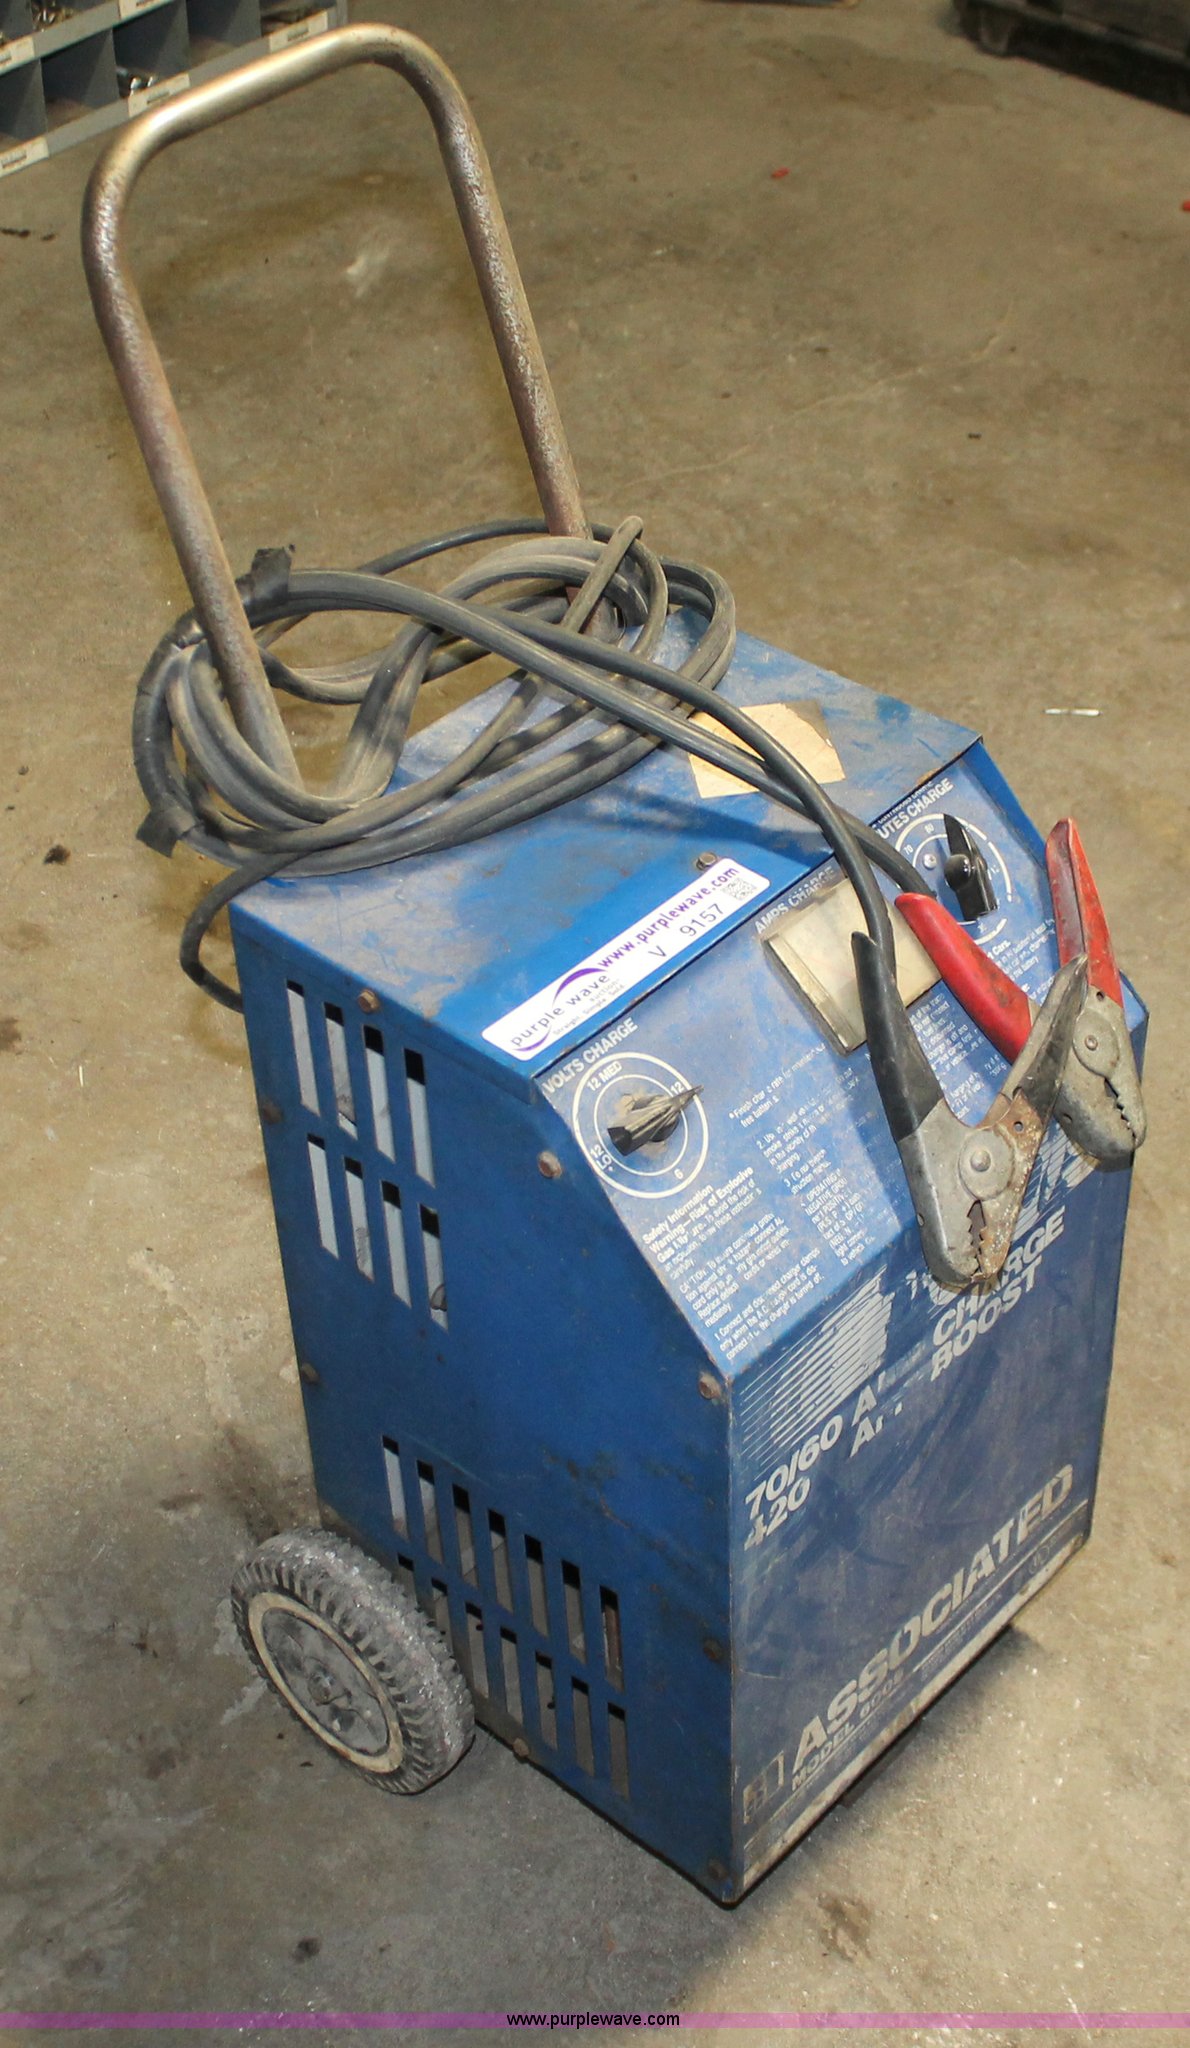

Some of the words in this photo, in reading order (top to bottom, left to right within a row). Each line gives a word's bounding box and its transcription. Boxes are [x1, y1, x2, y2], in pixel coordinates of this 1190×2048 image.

[875, 810, 910, 840] UTES
[905, 777, 953, 817] CHARGE
[903, 844, 914, 854] 70
[753, 901, 789, 933] AMPS
[786, 865, 837, 907] CHARGE
[599, 866, 739, 970] www.purplewave.com
[649, 945, 668, 959] V
[679, 902, 725, 938] 9157
[991, 937, 1010, 955] Cars.
[510, 1006, 563, 1047] purple
[567, 973, 609, 1006] wave
[542, 1058, 584, 1093] VOLTS
[582, 1016, 638, 1064] CHARGE
[586, 1075, 601, 1091] 12
[599, 1061, 622, 1084] MED
[671, 1081, 684, 1096] 12
[590, 1144, 604, 1159] 12
[596, 1154, 612, 1170] LO
[674, 1168, 684, 1179] 6
[706, 1194, 717, 1206] of
[715, 1164, 755, 1201] Explosive
[805, 1172, 836, 1201] OPERATING
[642, 1219, 670, 1247] Safety
[667, 1182, 713, 1223] Information
[804, 1189, 832, 1215] NEGATIVE
[656, 1245, 674, 1263] Gas
[697, 1296, 722, 1320] Replace
[718, 1313, 742, 1337] Connect
[744, 1477, 812, 1550] 420
[931, 1255, 1042, 1381] BOOST
[745, 1416, 843, 1520] 70/60
[792, 1464, 1073, 1775] ASSOCIATED
[792, 1722, 855, 1791] MODEL
